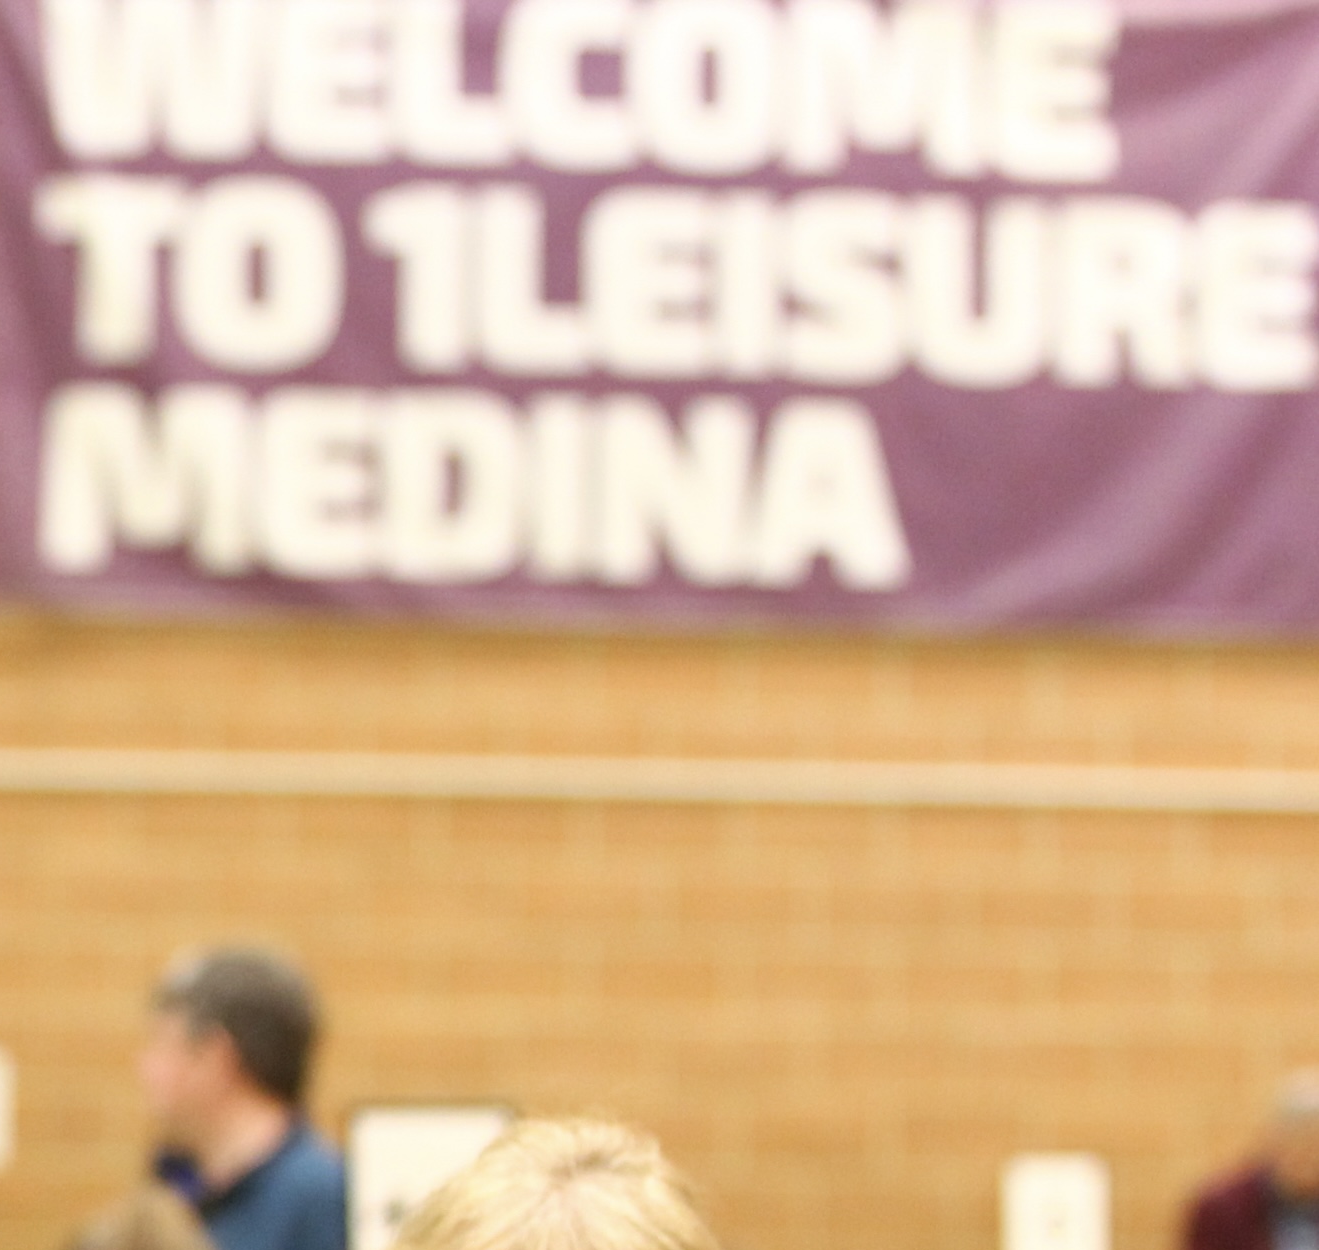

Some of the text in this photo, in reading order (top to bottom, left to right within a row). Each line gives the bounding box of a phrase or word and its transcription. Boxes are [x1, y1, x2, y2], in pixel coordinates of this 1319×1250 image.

[38, 0, 1122, 183] WELCOME
[36, 172, 1319, 392] TO 1LEISURE
[39, 382, 910, 590] MEDINA
